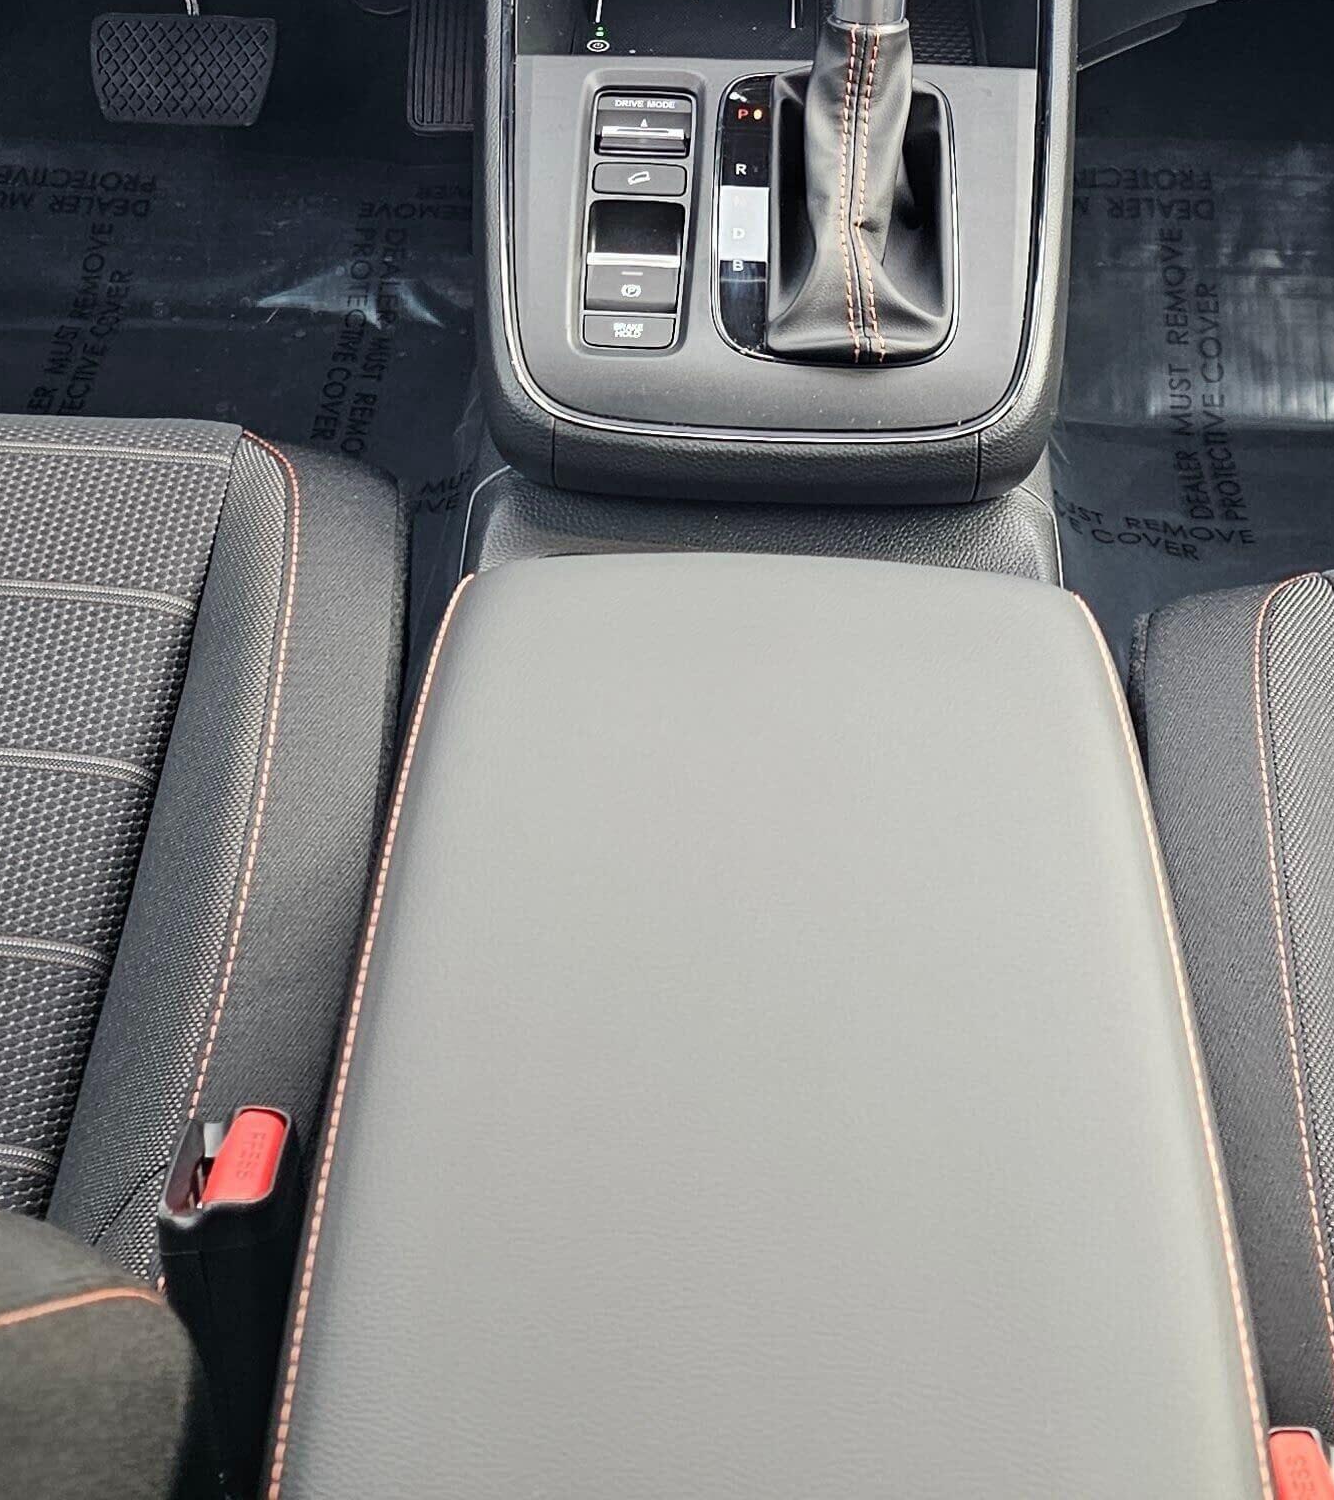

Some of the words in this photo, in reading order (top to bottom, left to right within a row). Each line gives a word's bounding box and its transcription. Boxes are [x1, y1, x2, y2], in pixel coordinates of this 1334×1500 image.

[614, 99, 645, 108] DRIVE
[647, 100, 676, 109] MODE
[737, 108, 749, 120] P
[0, 167, 158, 194] PROTECTIVE
[735, 163, 747, 175] R
[48, 195, 153, 219] DEALER
[1106, 196, 1215, 221] DEALER
[732, 228, 745, 239] D
[377, 226, 409, 324] DEALER
[732, 259, 744, 271] B
[42, 325, 82, 377] MUST
[68, 221, 114, 322] REMOVE
[89, 269, 134, 340] COVER
[331, 226, 375, 364] PROTECTIVE
[1154, 227, 1190, 348] REMOVE
[613, 322, 644, 332] BRAKE
[614, 330, 642, 339] HOLD
[1195, 281, 1225, 387] COVER
[359, 335, 391, 383] MUST
[311, 366, 353, 442] COVER
[1166, 362, 1196, 437] MUST
[1200, 393, 1251, 523] PROTECTIVE
[1173, 445, 1215, 521] DEALER
[1090, 528, 1200, 562] COVER
[1124, 515, 1257, 546] REMOVE
